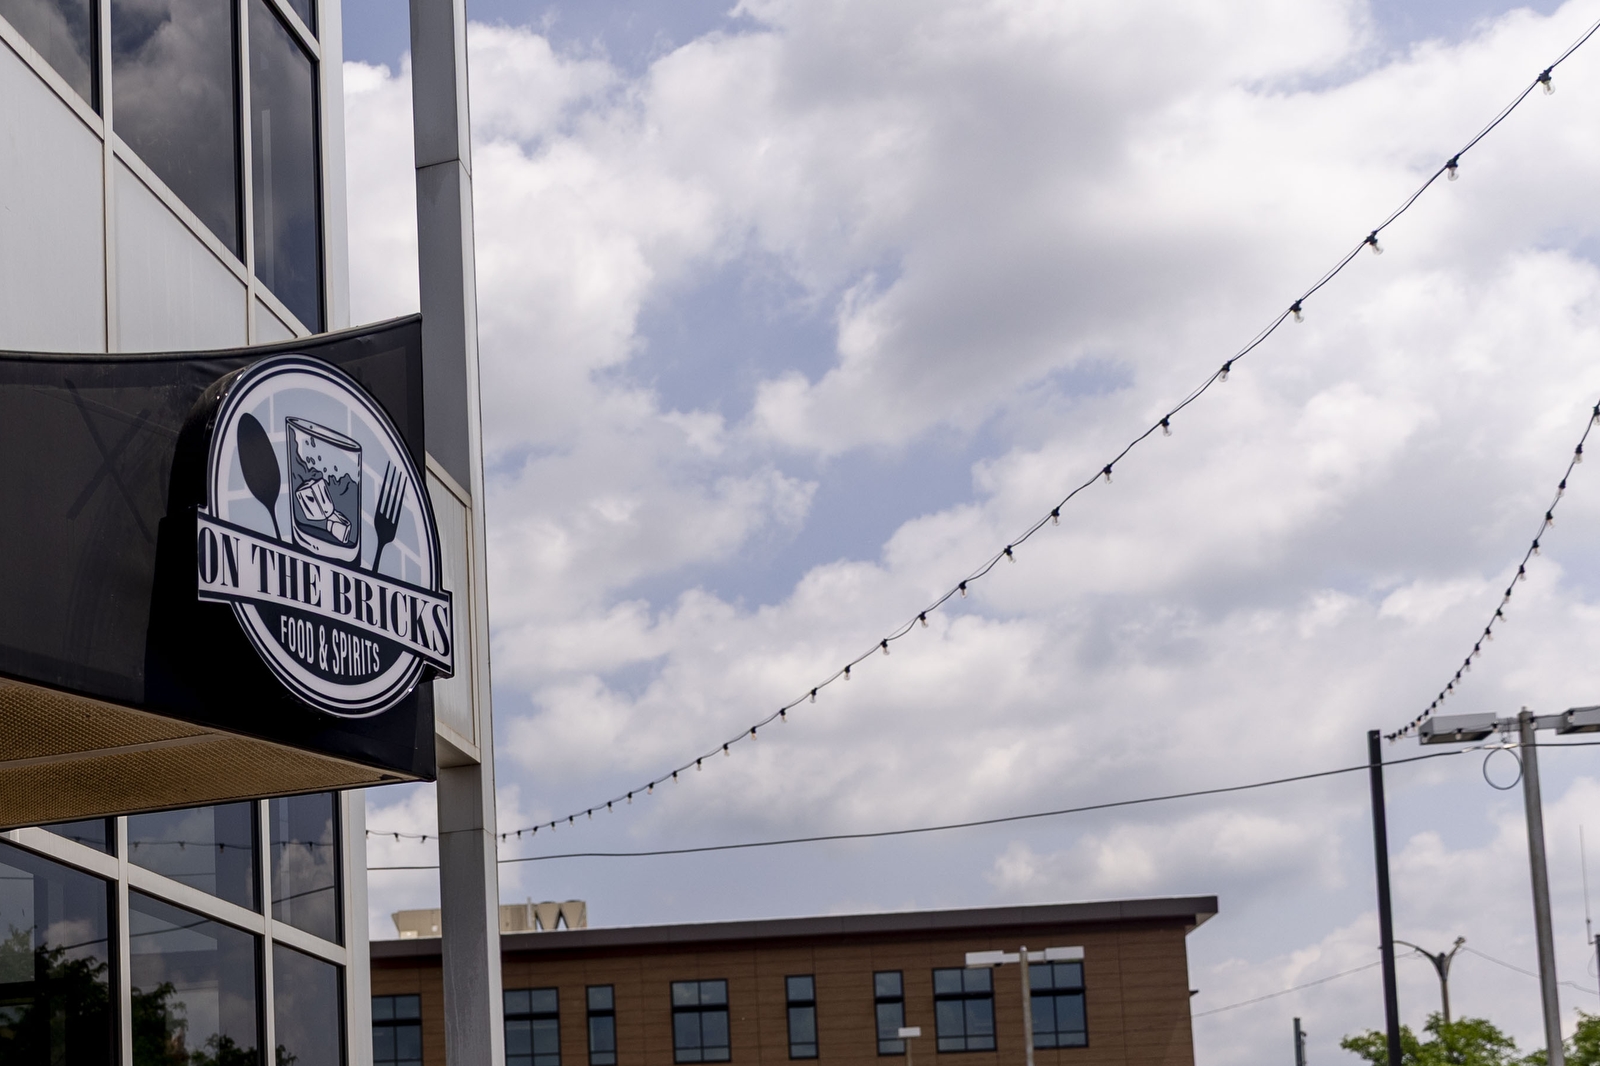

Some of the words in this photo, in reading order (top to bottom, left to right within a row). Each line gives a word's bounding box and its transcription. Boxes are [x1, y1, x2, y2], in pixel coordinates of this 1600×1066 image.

[199, 527, 241, 589] ON
[251, 544, 321, 609] THE
[330, 569, 450, 657] BRICKS
[281, 615, 314, 665] FOOD
[319, 625, 329, 671] &
[331, 628, 380, 677] SPIRITS
